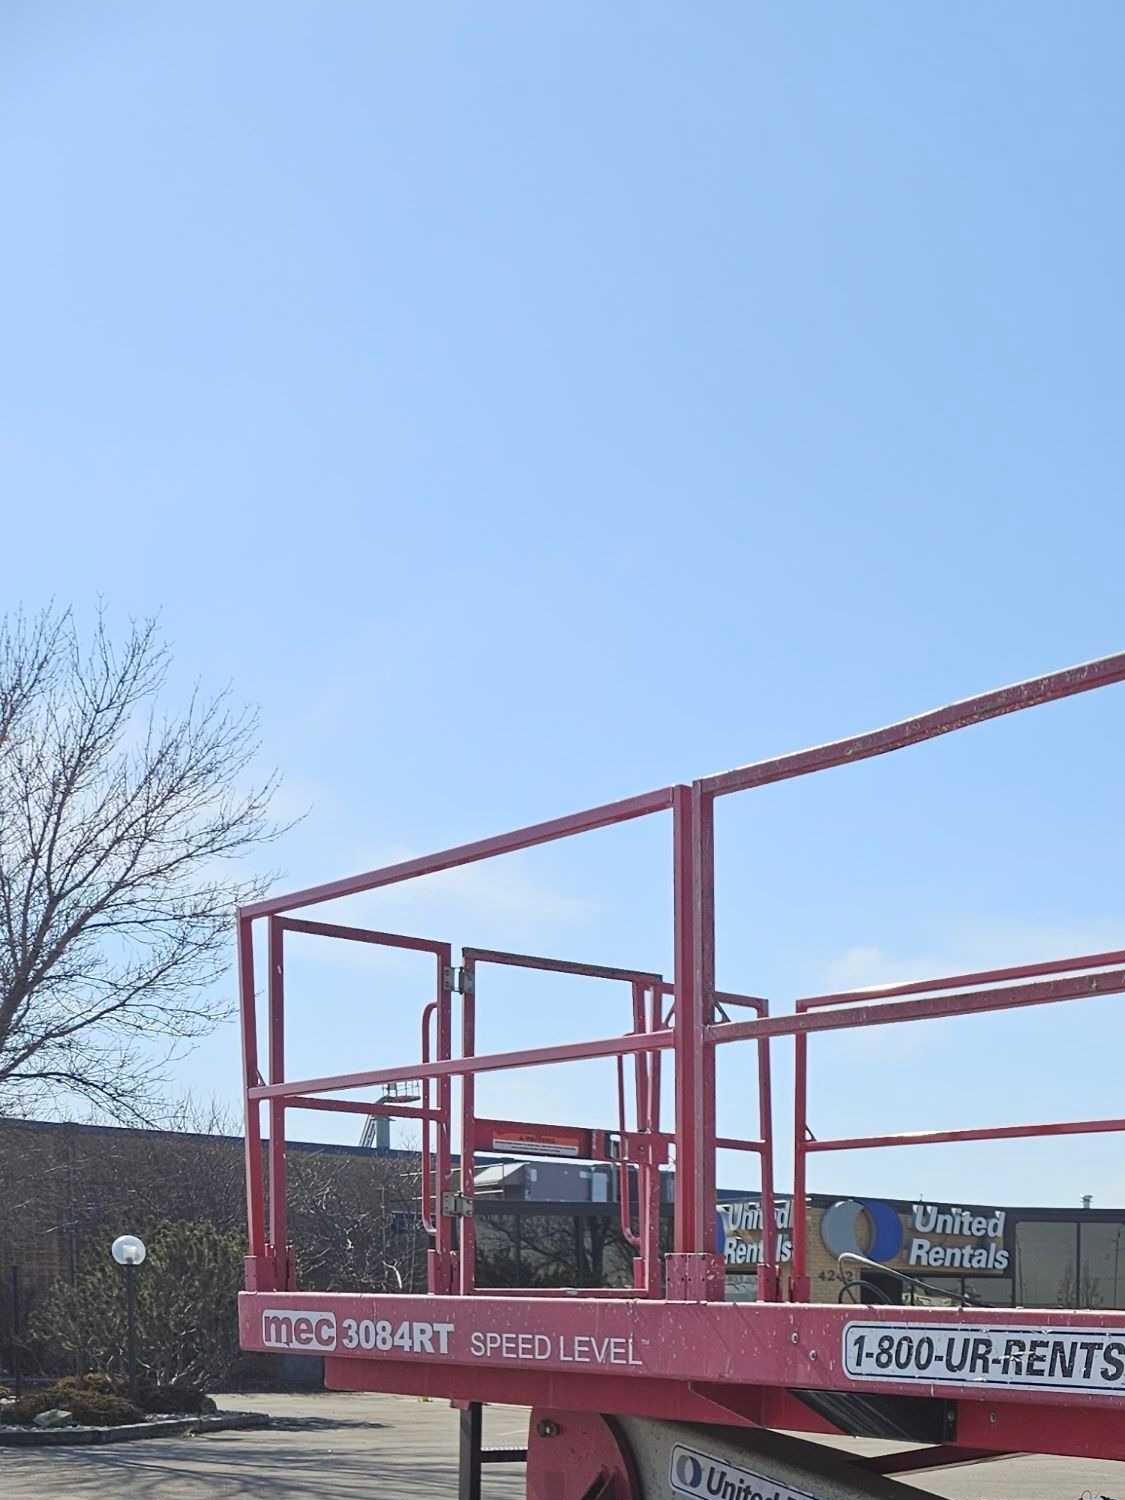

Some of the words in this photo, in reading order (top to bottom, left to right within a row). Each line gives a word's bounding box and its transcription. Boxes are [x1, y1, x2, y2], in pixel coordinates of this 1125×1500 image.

[912, 1205, 1006, 1238] United
[909, 1238, 1010, 1270] Rentals
[263, 1315, 336, 1347] mec
[342, 1318, 454, 1354] 3084RT
[470, 1331, 552, 1361] SPEED
[559, 1336, 644, 1365] LEVEL
